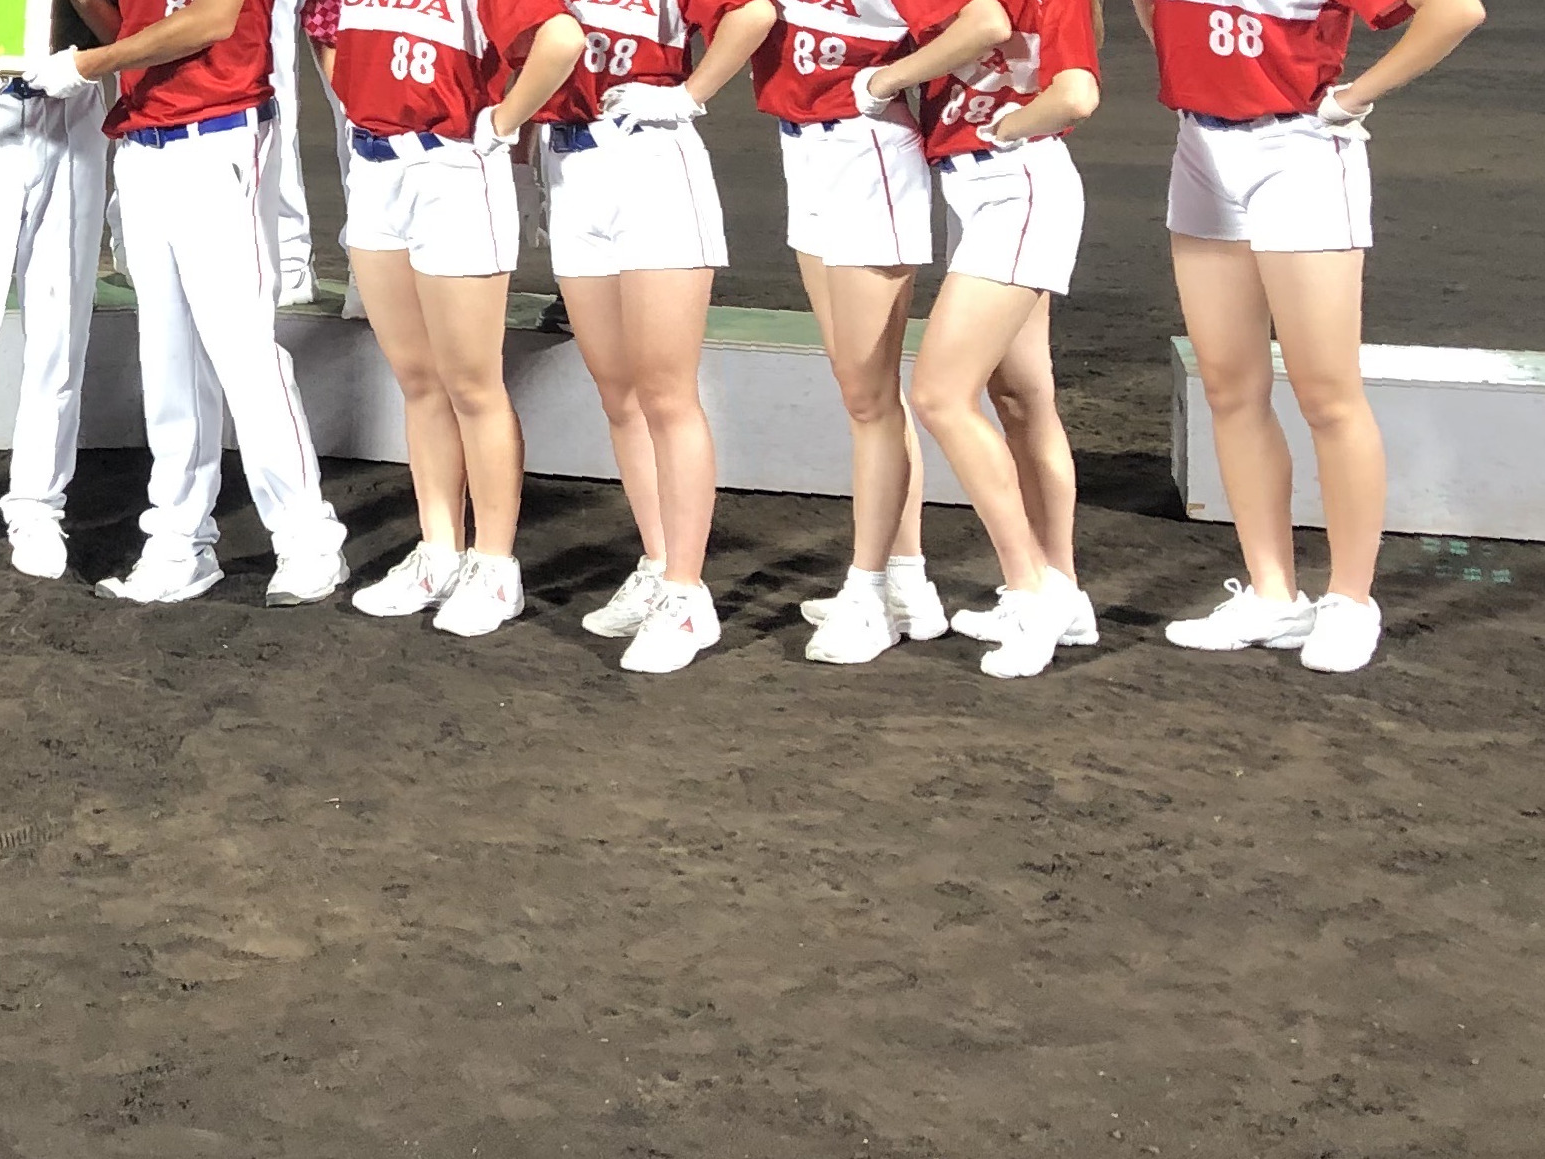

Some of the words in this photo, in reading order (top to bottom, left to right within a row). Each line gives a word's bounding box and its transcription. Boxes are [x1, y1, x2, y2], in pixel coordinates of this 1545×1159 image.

[583, 31, 638, 77] 88
[792, 30, 847, 75] 88
[1208, 9, 1265, 59] 88
[390, 36, 437, 84] 88
